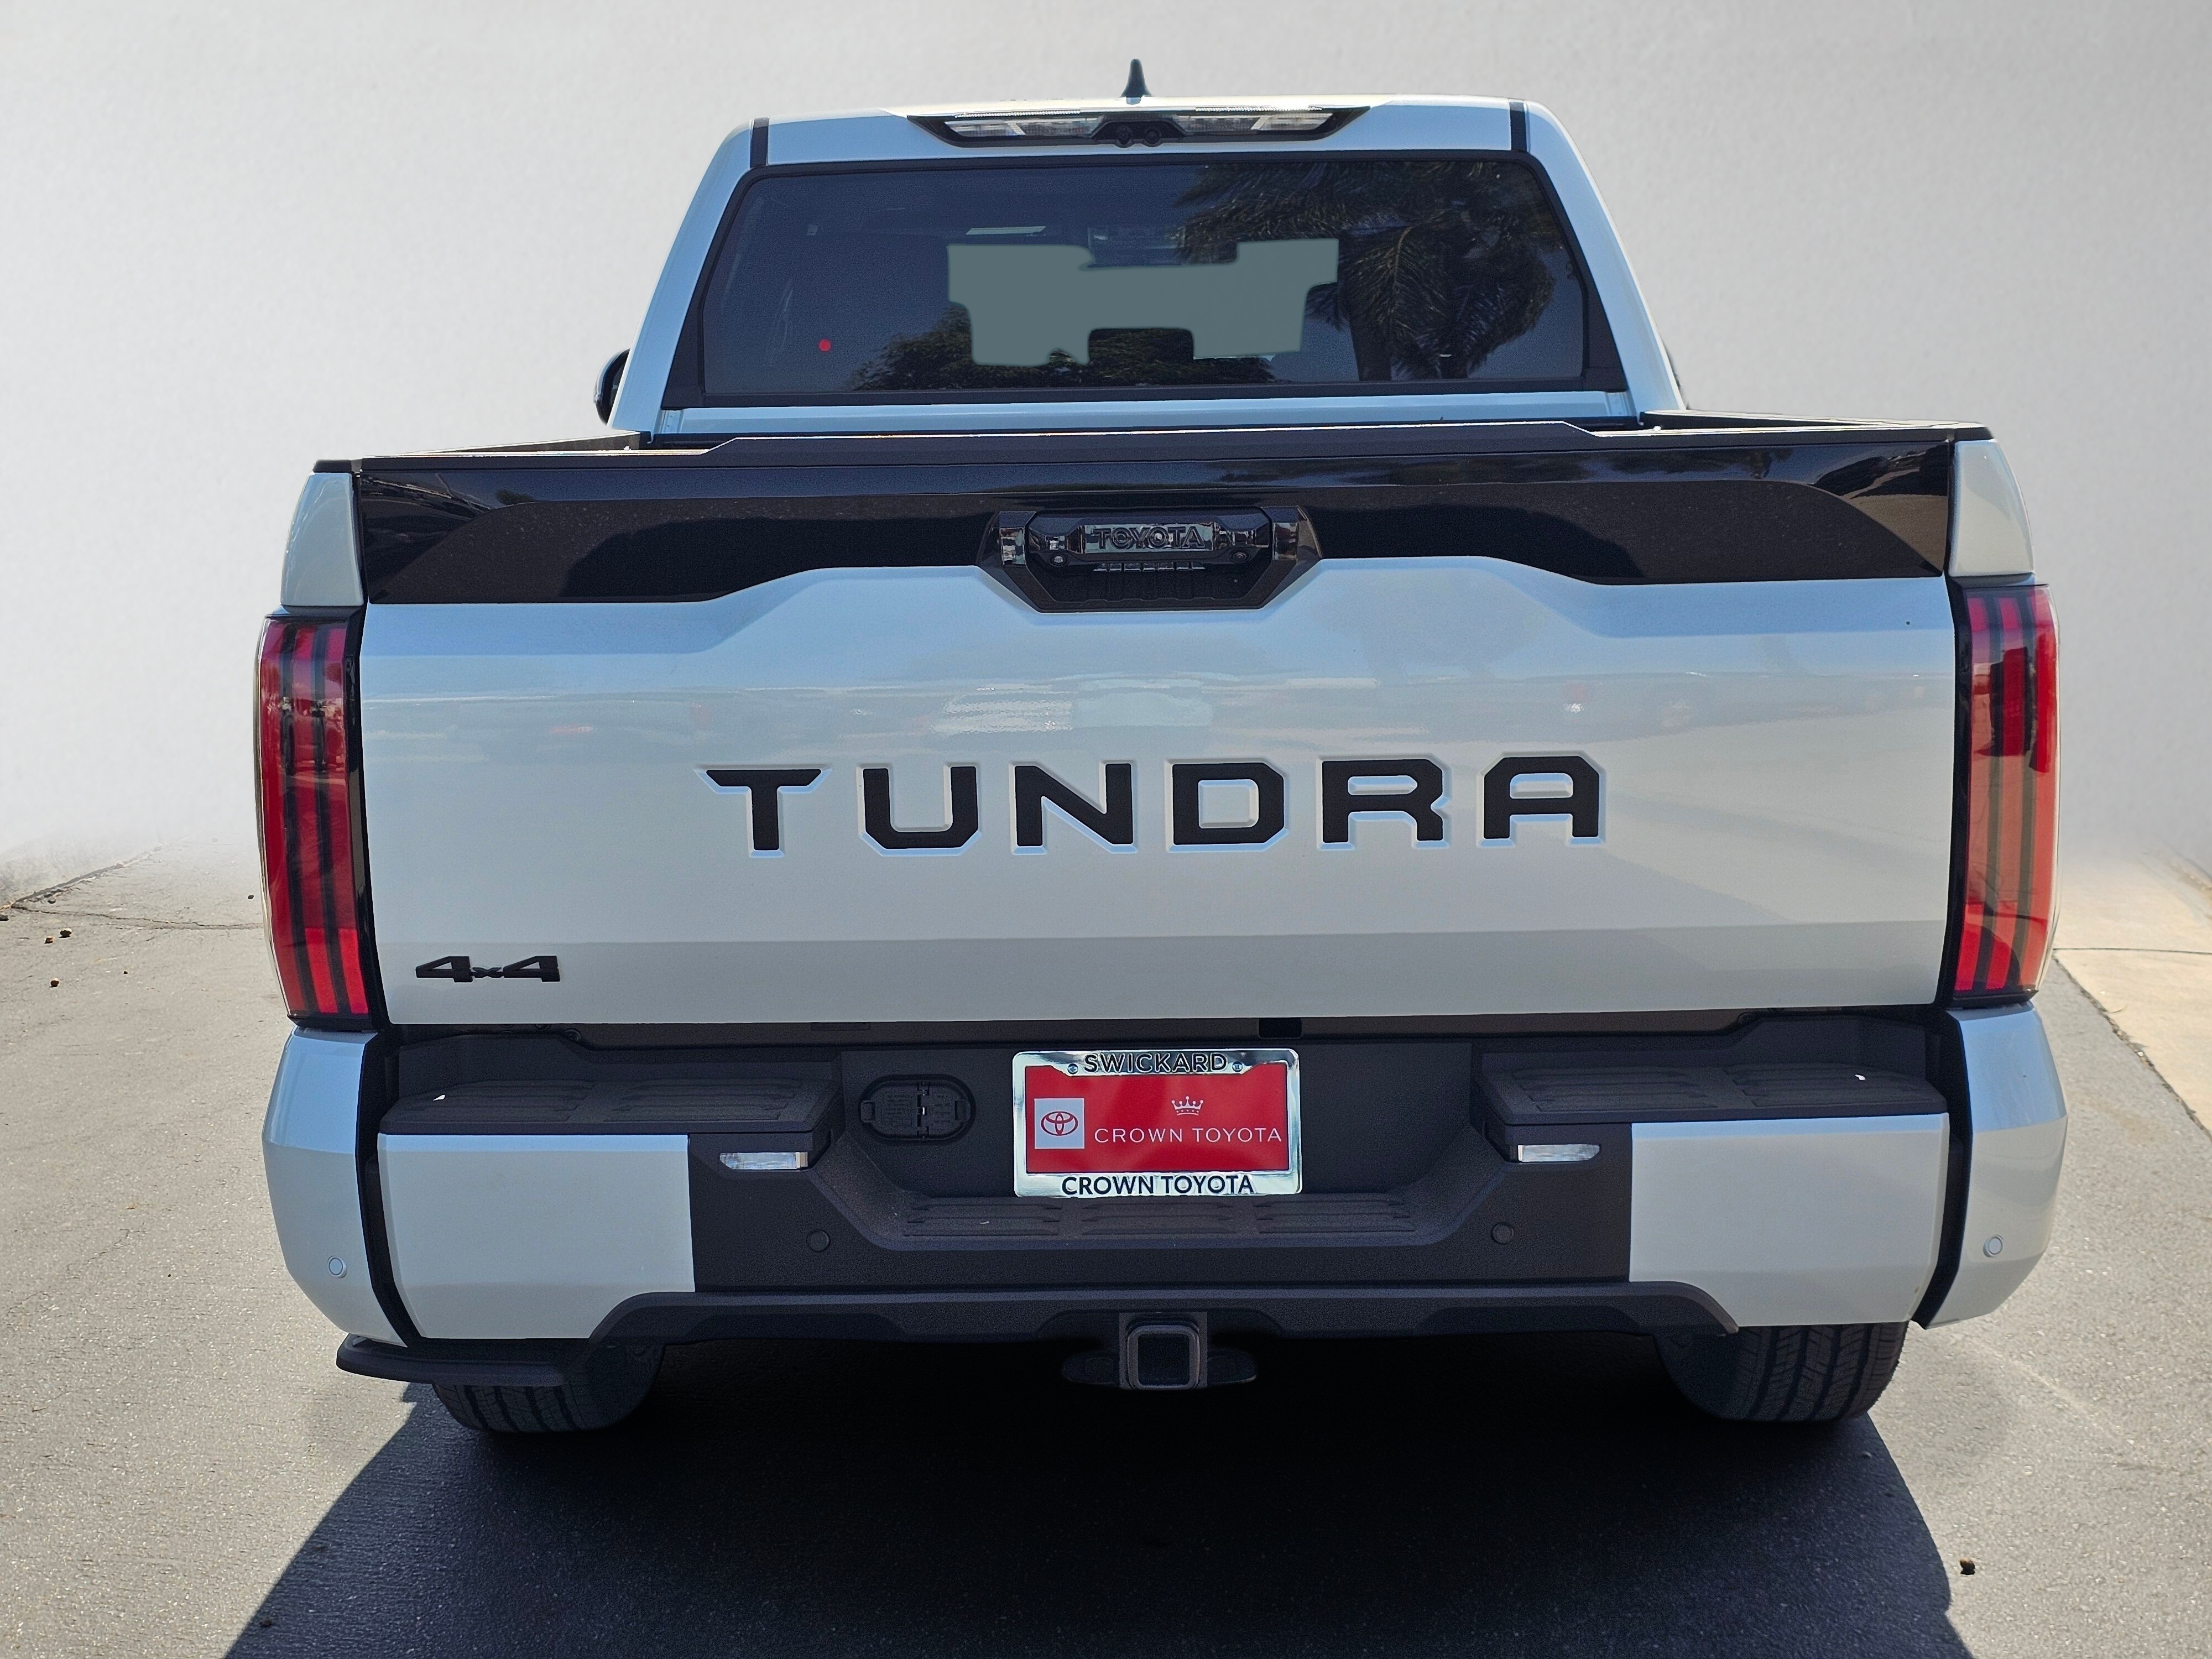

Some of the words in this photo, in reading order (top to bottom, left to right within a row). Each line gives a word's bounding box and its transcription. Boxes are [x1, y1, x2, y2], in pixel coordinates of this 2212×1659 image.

[1093, 525, 1206, 549] TOYOTA
[703, 754, 1605, 852] TUNDRA
[415, 956, 561, 983] 4x4
[1083, 1053, 1228, 1073] SWICKARD
[1094, 1128, 1183, 1143] CROWN
[1193, 1128, 1282, 1142] TOYOTA
[1062, 1176, 1154, 1195] CROWN
[1161, 1175, 1254, 1194] TOYOTA
